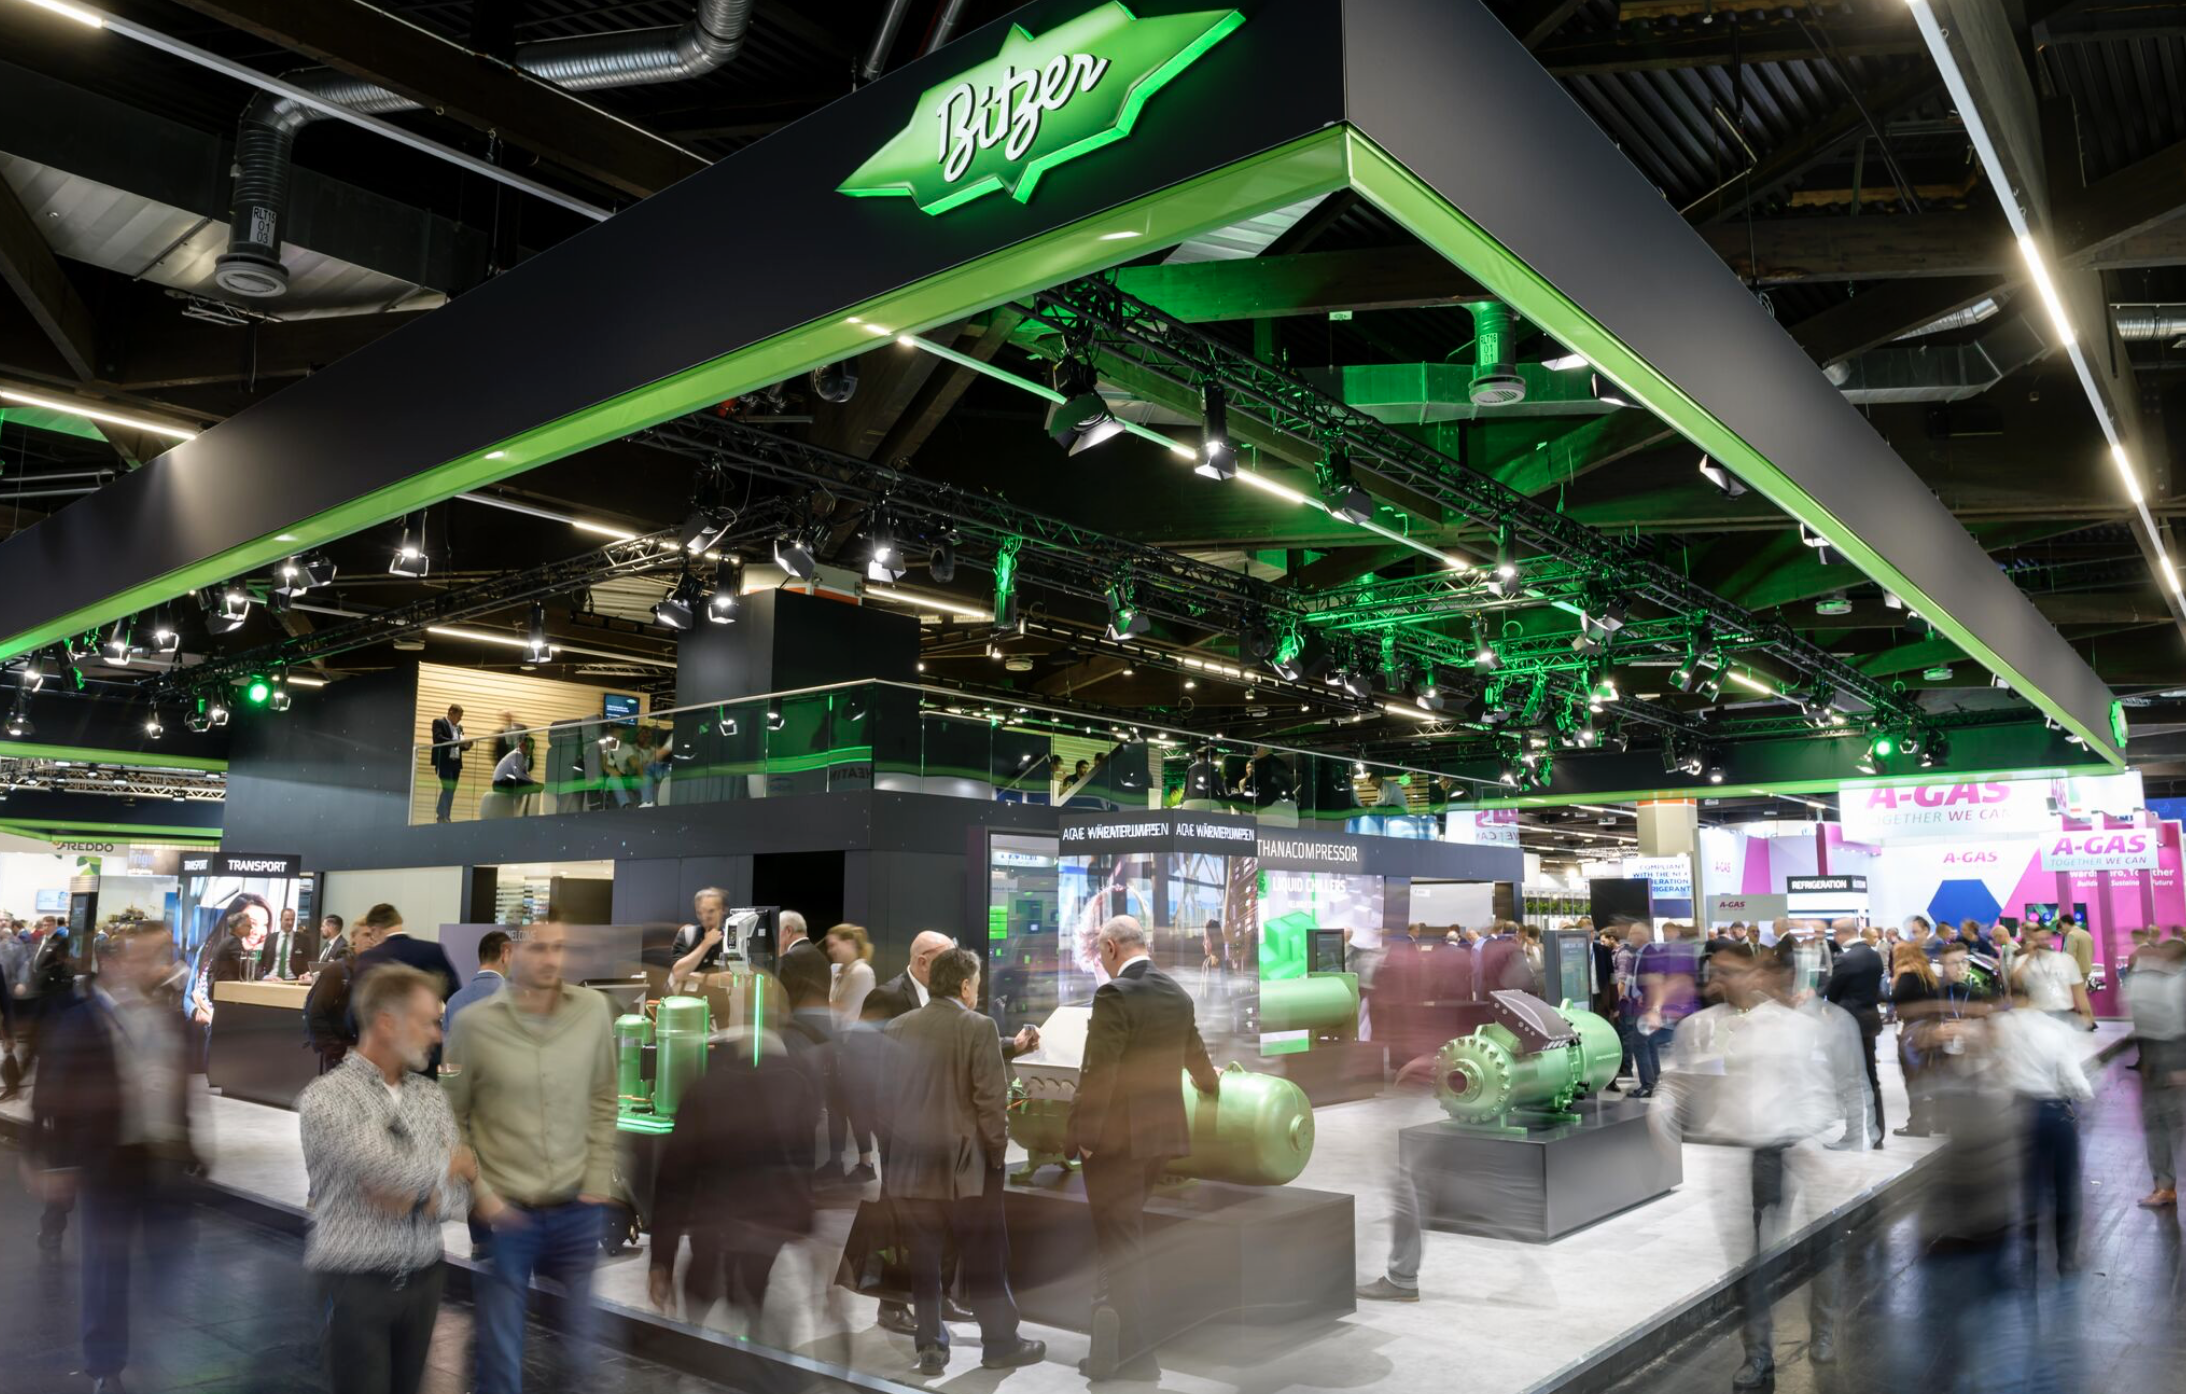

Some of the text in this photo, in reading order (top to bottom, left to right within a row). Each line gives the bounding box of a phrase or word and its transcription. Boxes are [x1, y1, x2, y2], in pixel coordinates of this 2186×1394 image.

[937, 53, 1111, 183] Bitzer
[254, 207, 275, 224] RLT15
[1866, 775, 2011, 809] A-GAS
[1874, 811, 1943, 825] OGETHER
[1948, 809, 1972, 822] WE
[2051, 834, 2147, 856] A-GAS
[1943, 851, 1998, 863] A-GAS
[2051, 856, 2147, 867] TOGETHER WE CAN
[227, 859, 287, 873] TRANSPORT
[1272, 876, 1303, 895] LIQUID
[1719, 901, 1746, 909] A-GAS
